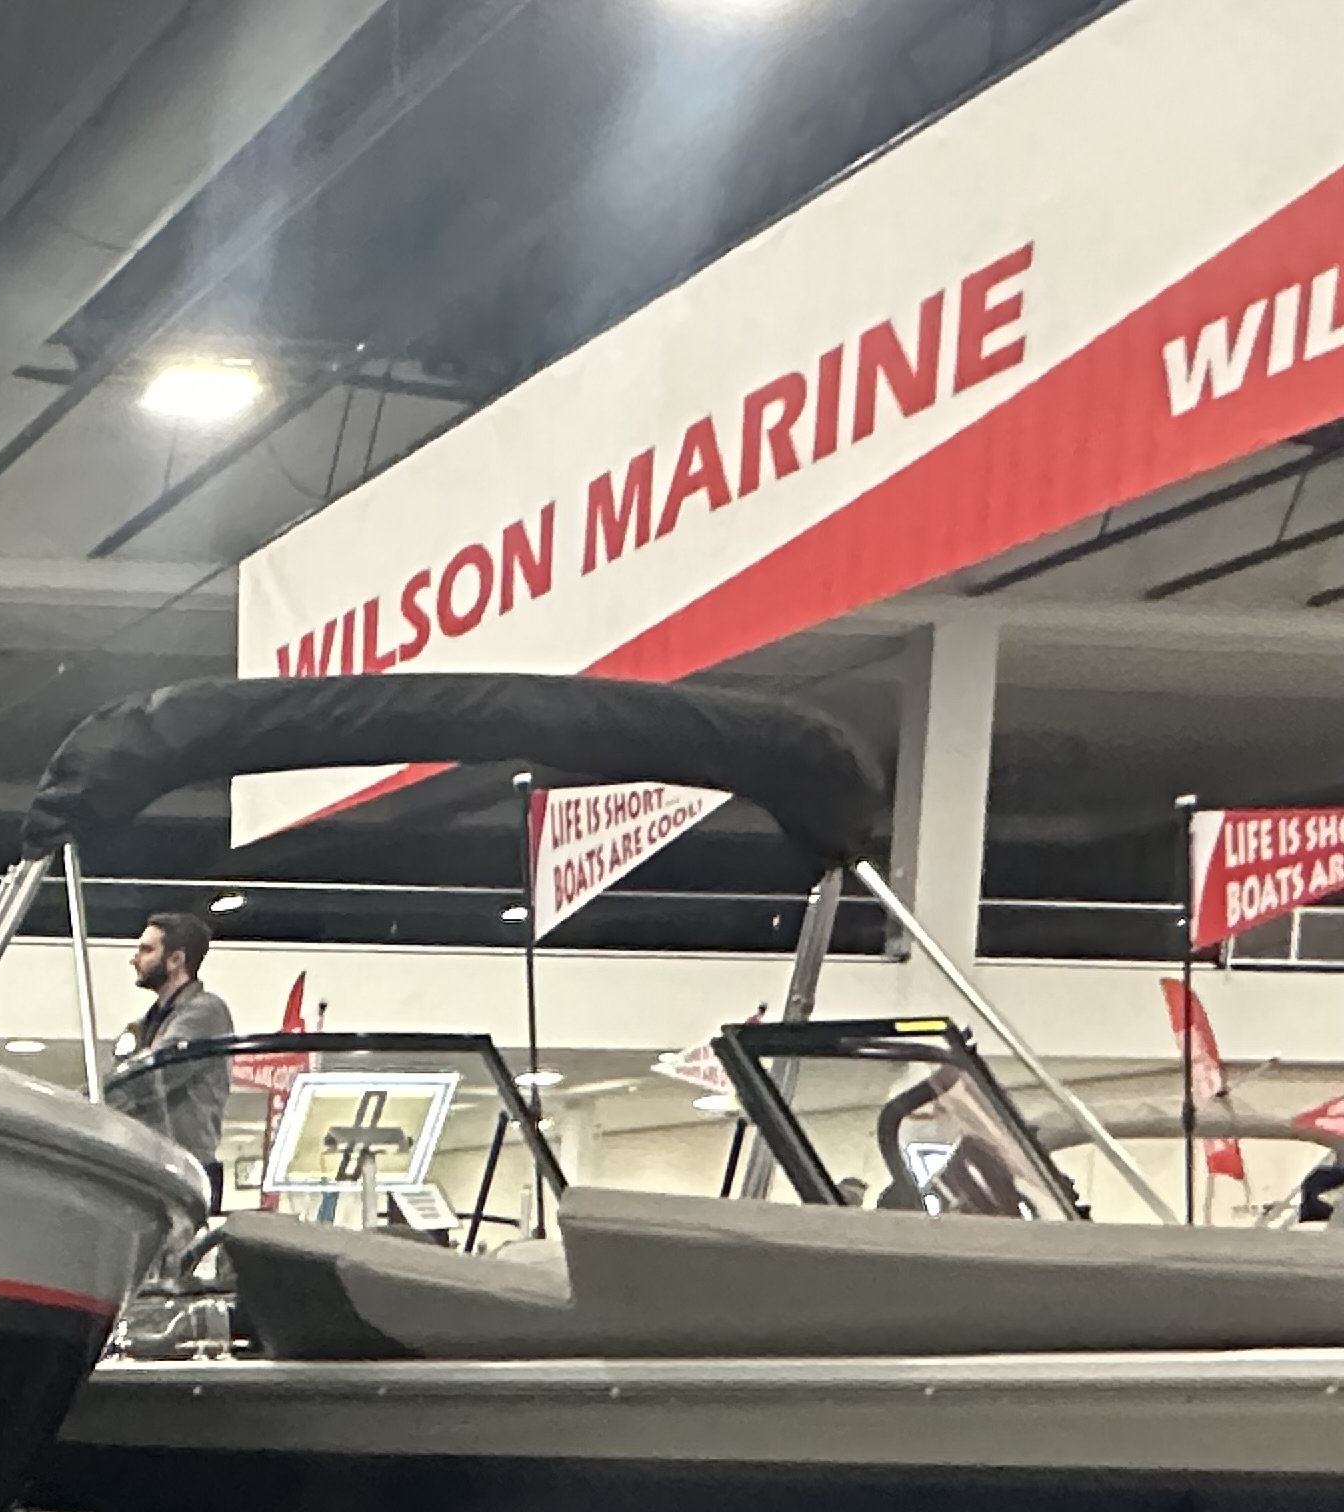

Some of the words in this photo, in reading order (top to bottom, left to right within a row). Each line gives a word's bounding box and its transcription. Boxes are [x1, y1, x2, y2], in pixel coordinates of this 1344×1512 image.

[274, 500, 555, 679] WILSON
[581, 240, 1034, 577] MARINE
[550, 797, 582, 850] LIFE
[586, 793, 601, 836] IS
[1224, 819, 1273, 868] LIFE
[1278, 816, 1301, 857] IS
[1304, 814, 1344, 852] SH
[553, 844, 605, 913] BOATS
[608, 826, 643, 874] ARE
[646, 798, 704, 845] COOL!
[1225, 862, 1304, 928] BOATS
